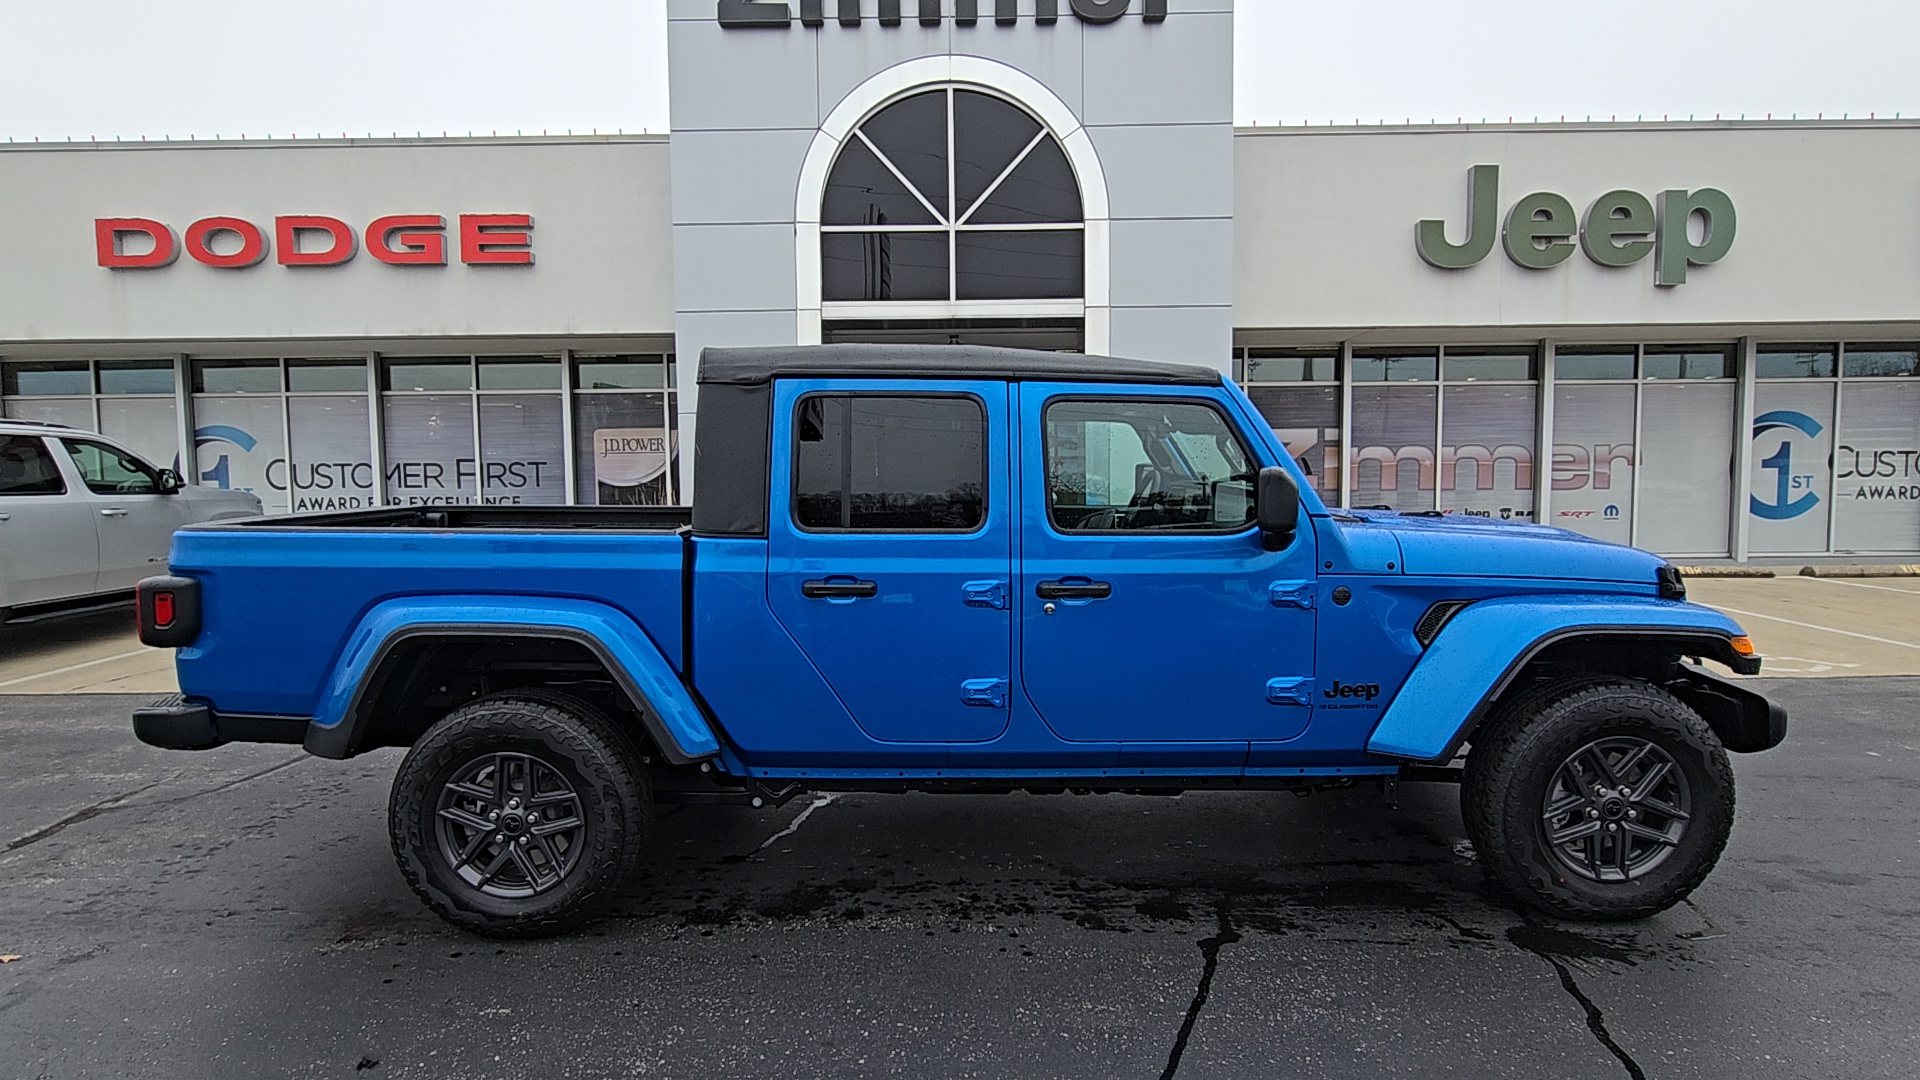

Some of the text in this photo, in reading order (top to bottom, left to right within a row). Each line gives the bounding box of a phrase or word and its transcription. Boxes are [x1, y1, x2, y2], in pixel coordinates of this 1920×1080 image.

[1414, 164, 1737, 287] Jeep
[95, 214, 535, 269] DODGE
[622, 437, 666, 452] POWER
[1828, 445, 1920, 478] CUST
[296, 496, 361, 511] AWARD
[1557, 510, 1595, 518] SRT
[1324, 680, 1380, 701] Jeep
